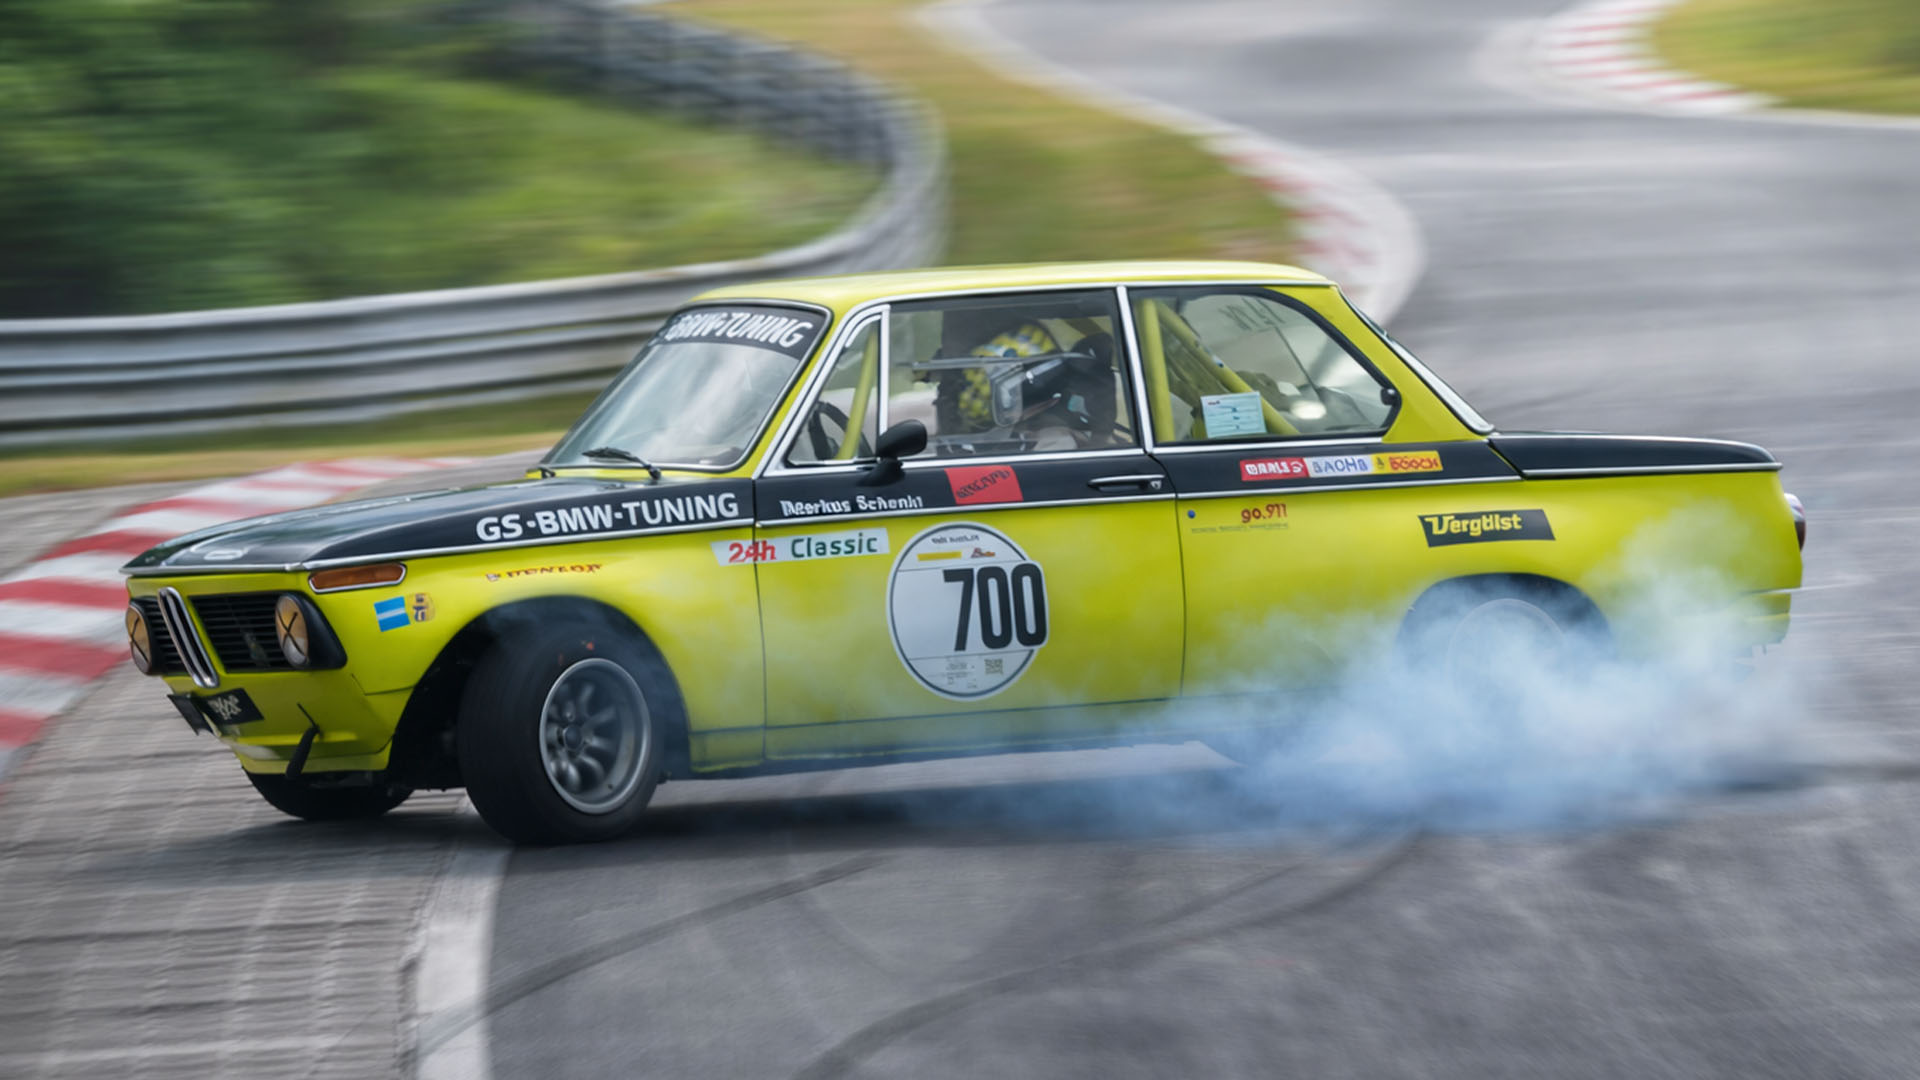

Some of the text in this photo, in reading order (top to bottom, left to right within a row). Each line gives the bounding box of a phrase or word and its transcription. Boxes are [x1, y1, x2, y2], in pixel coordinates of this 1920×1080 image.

[728, 533, 878, 563] 24h Classic
[942, 562, 1047, 652] 700
